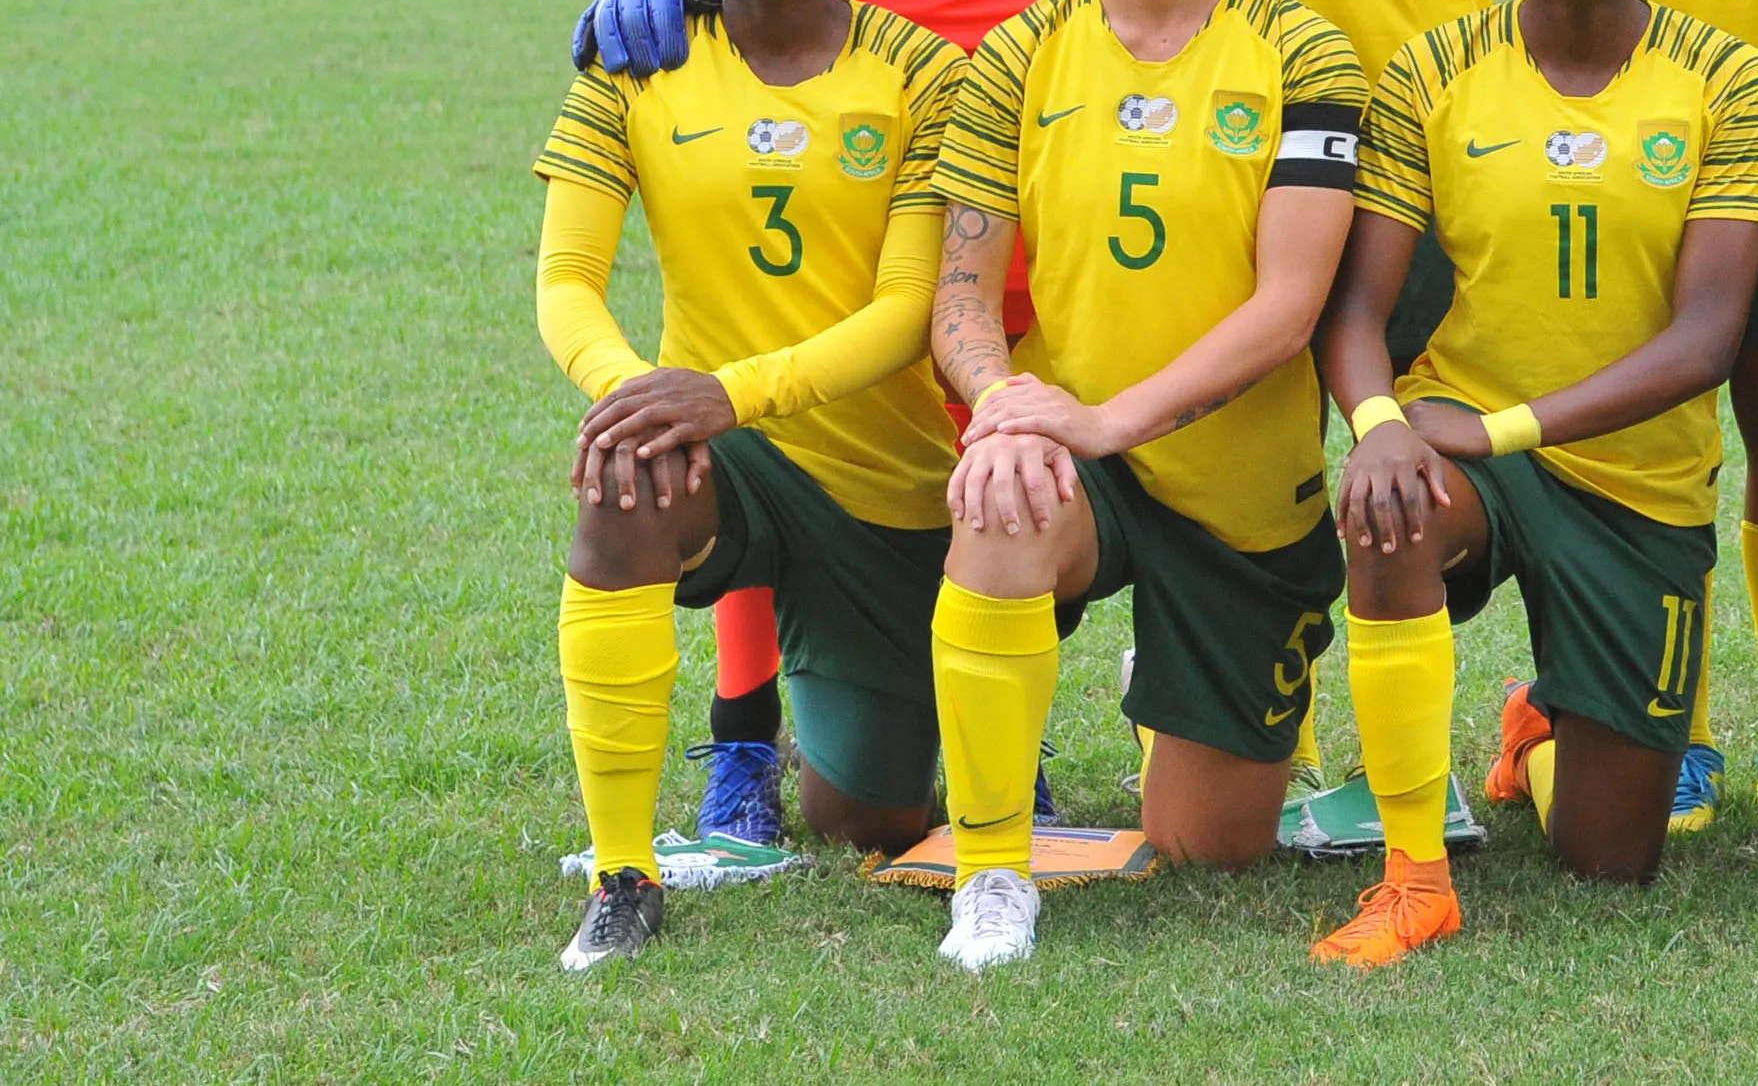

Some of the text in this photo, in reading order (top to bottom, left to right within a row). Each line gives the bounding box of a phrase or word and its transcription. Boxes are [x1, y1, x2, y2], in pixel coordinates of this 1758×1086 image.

[748, 185, 803, 277] 3
[1108, 172, 1166, 270] 5
[1550, 204, 1598, 299] 11
[1274, 611, 1323, 696] 5
[1657, 595, 1697, 695] 11
